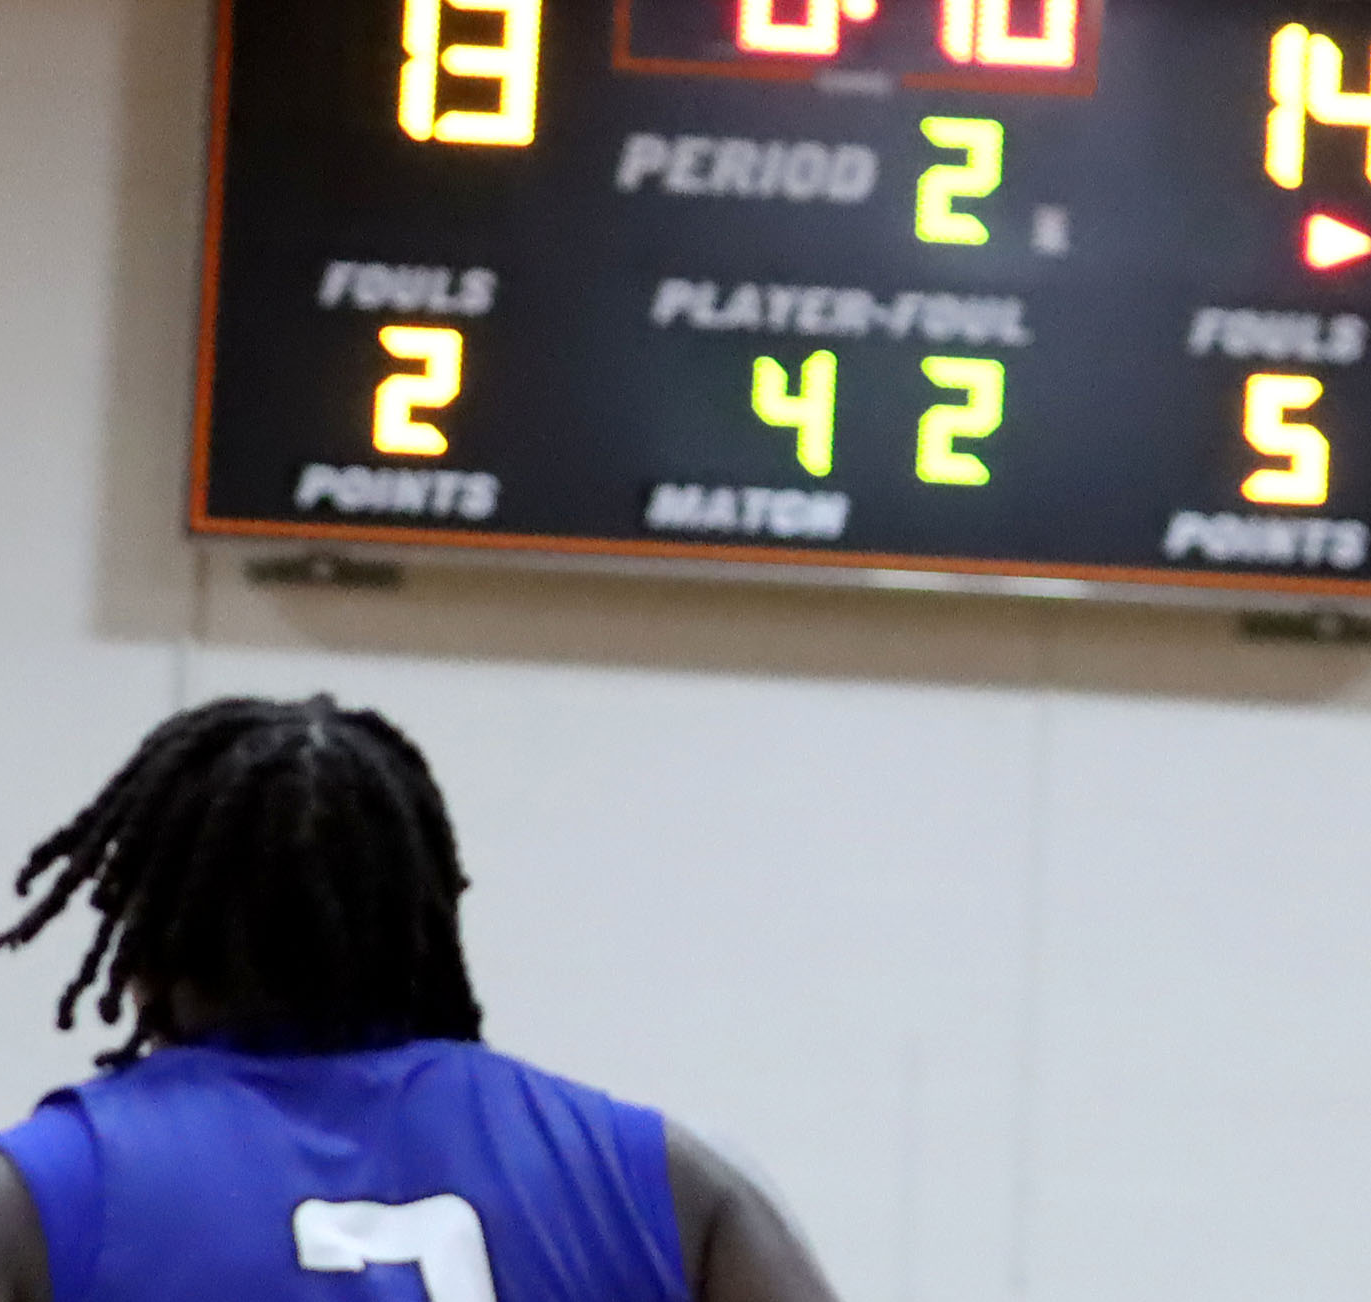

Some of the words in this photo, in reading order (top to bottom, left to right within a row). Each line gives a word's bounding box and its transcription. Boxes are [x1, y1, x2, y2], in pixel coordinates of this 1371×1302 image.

[398, 0, 543, 147] 13
[615, 132, 880, 202] PERIOD
[914, 115, 1005, 246] 2
[317, 259, 500, 317] FOULS
[1188, 306, 1370, 364] FOULS
[371, 325, 464, 457] 2
[750, 349, 839, 478] 4
[914, 355, 1006, 486] 2
[1239, 372, 1332, 507] 5
[294, 461, 502, 522] POINTS
[1163, 510, 1371, 571] POINTS
